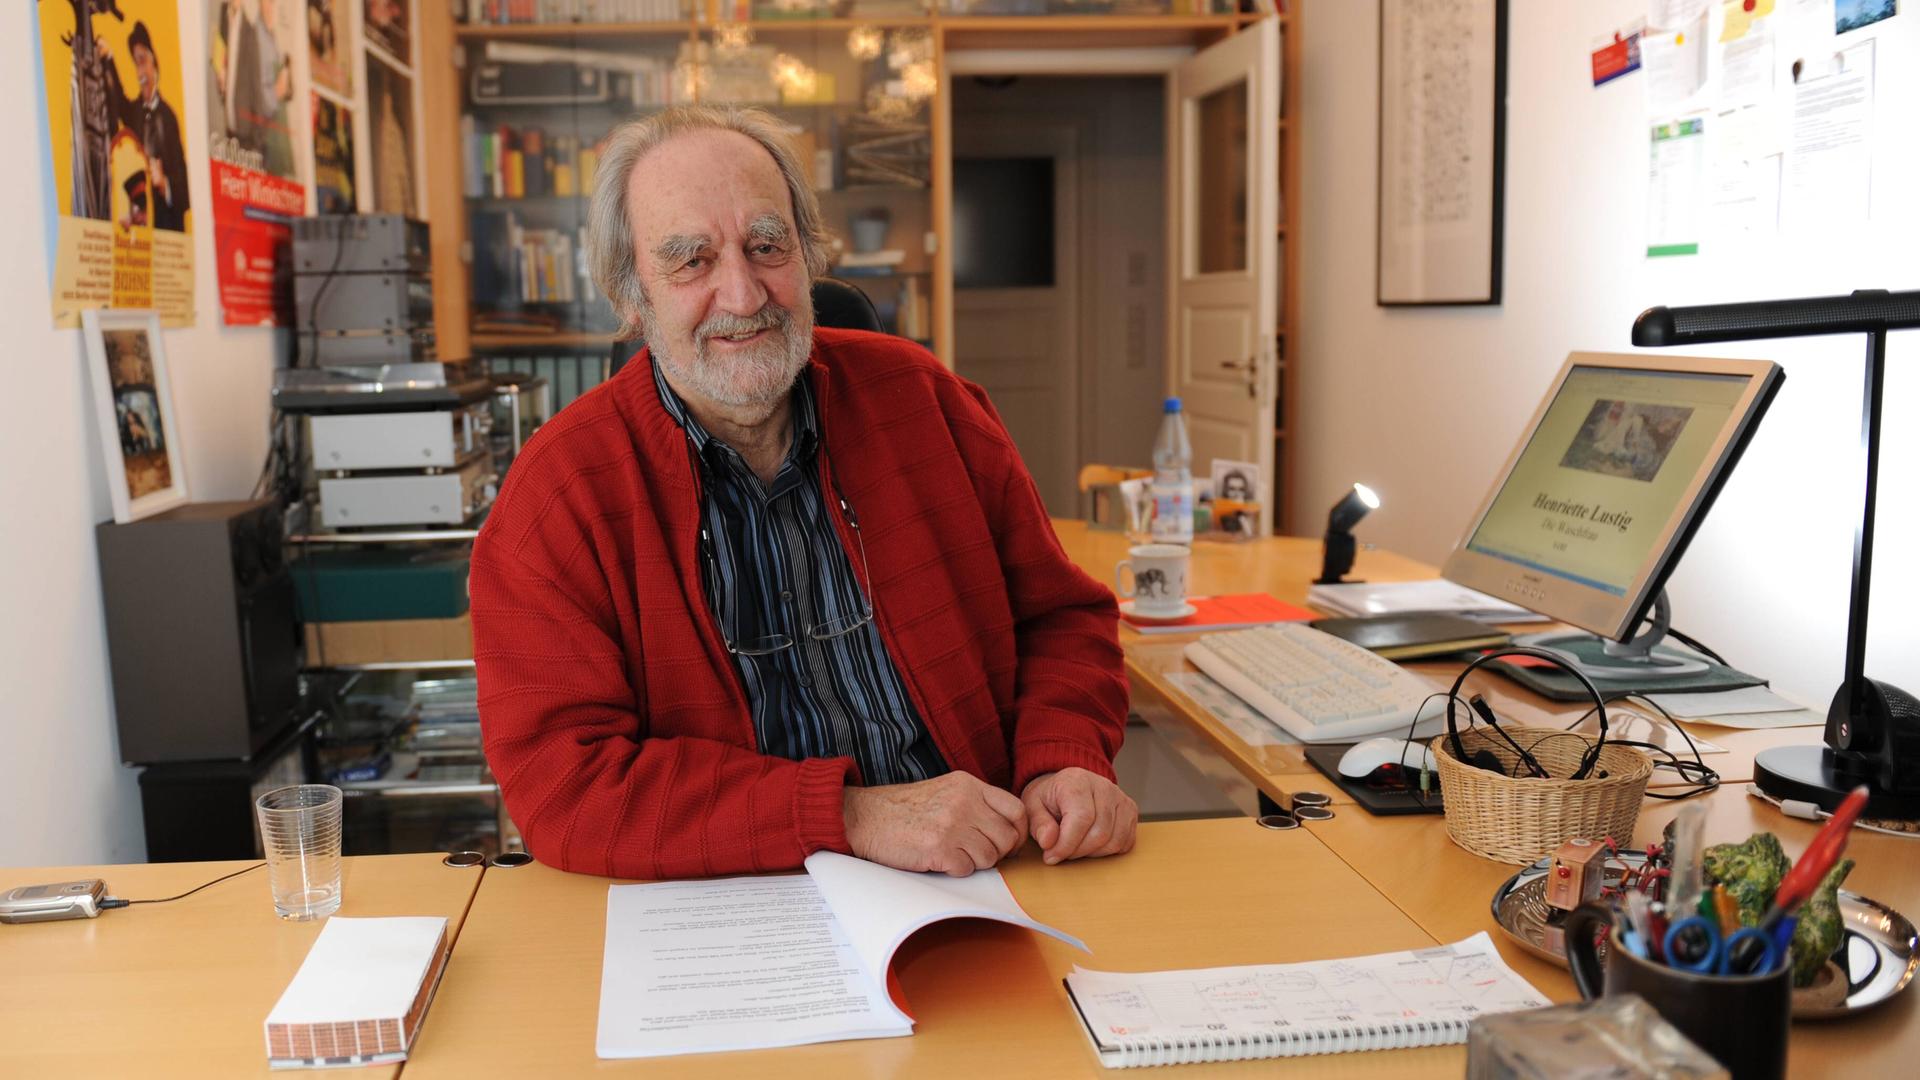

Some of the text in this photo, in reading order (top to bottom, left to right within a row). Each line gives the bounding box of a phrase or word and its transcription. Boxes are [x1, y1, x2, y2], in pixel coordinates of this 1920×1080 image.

[1532, 493, 1632, 532] Henriette Lustig
[1207, 1023, 1228, 1032] 20
[1273, 1019, 1291, 1027] 19
[1109, 1025, 1127, 1035] 21
